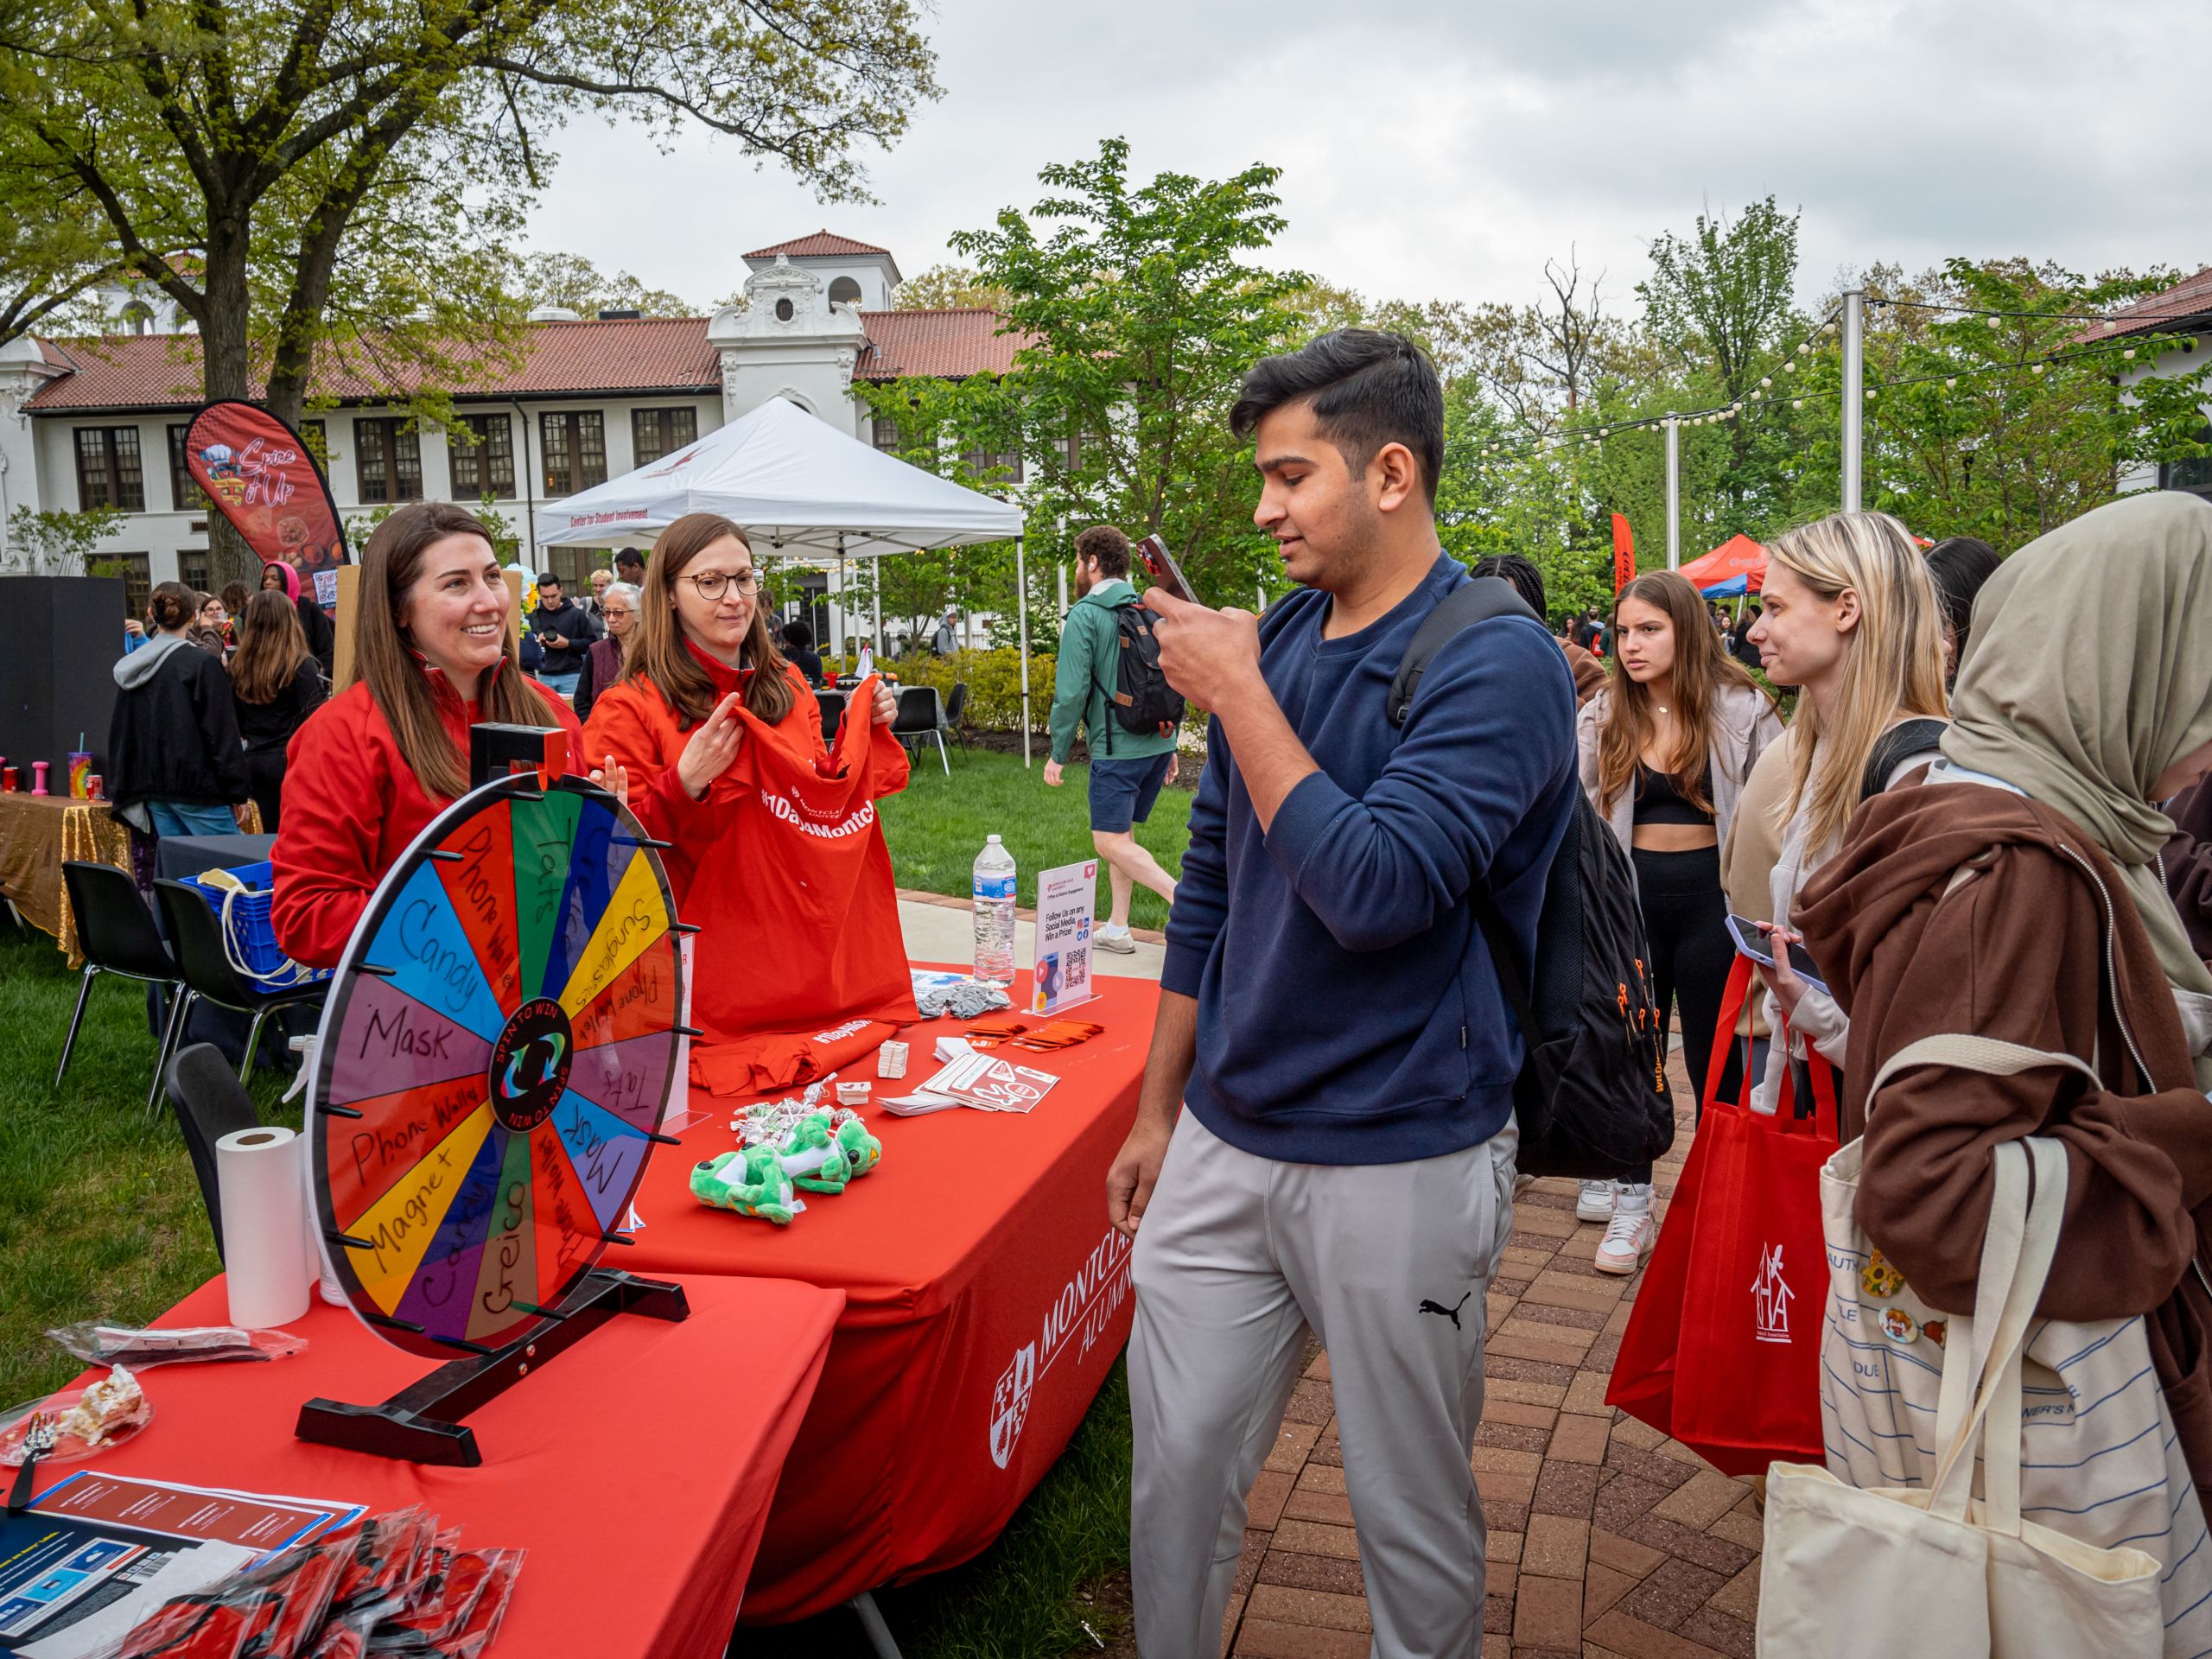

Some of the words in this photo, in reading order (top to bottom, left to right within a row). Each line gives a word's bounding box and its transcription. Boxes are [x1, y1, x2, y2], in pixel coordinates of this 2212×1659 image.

[239, 437, 296, 475] Spice
[262, 473, 295, 507] Up
[570, 516, 587, 528] Center
[595, 512, 615, 524] Student
[616, 508, 648, 521] Involvement
[799, 798, 844, 816] MONTCLA
[457, 825, 499, 925] Phone
[1046, 912, 1062, 922] Follow
[1062, 909, 1069, 918] Us
[1076, 906, 1084, 914] any
[1046, 920, 1060, 932] Social
[1060, 917, 1077, 928] Media,
[576, 898, 651, 1007] Sunglasses
[1045, 932, 1054, 942] Win
[1059, 926, 1072, 938] Prize!
[400, 899, 480, 1013] Candy
[359, 1004, 454, 1060] Mask
[496, 1022, 518, 1064] SPIN
[517, 1007, 533, 1024] TO
[535, 1001, 558, 1019] WIN
[548, 1065, 568, 1106] SPIN
[508, 1112, 532, 1128] WIN
[534, 1105, 550, 1123] TO
[351, 1121, 429, 1188] Phone
[563, 1103, 625, 1195] Mask
[370, 1147, 453, 1274] Magnet
[1039, 1226, 1130, 1365] MONTCLA
[1853, 1361, 1880, 1377] DUE
